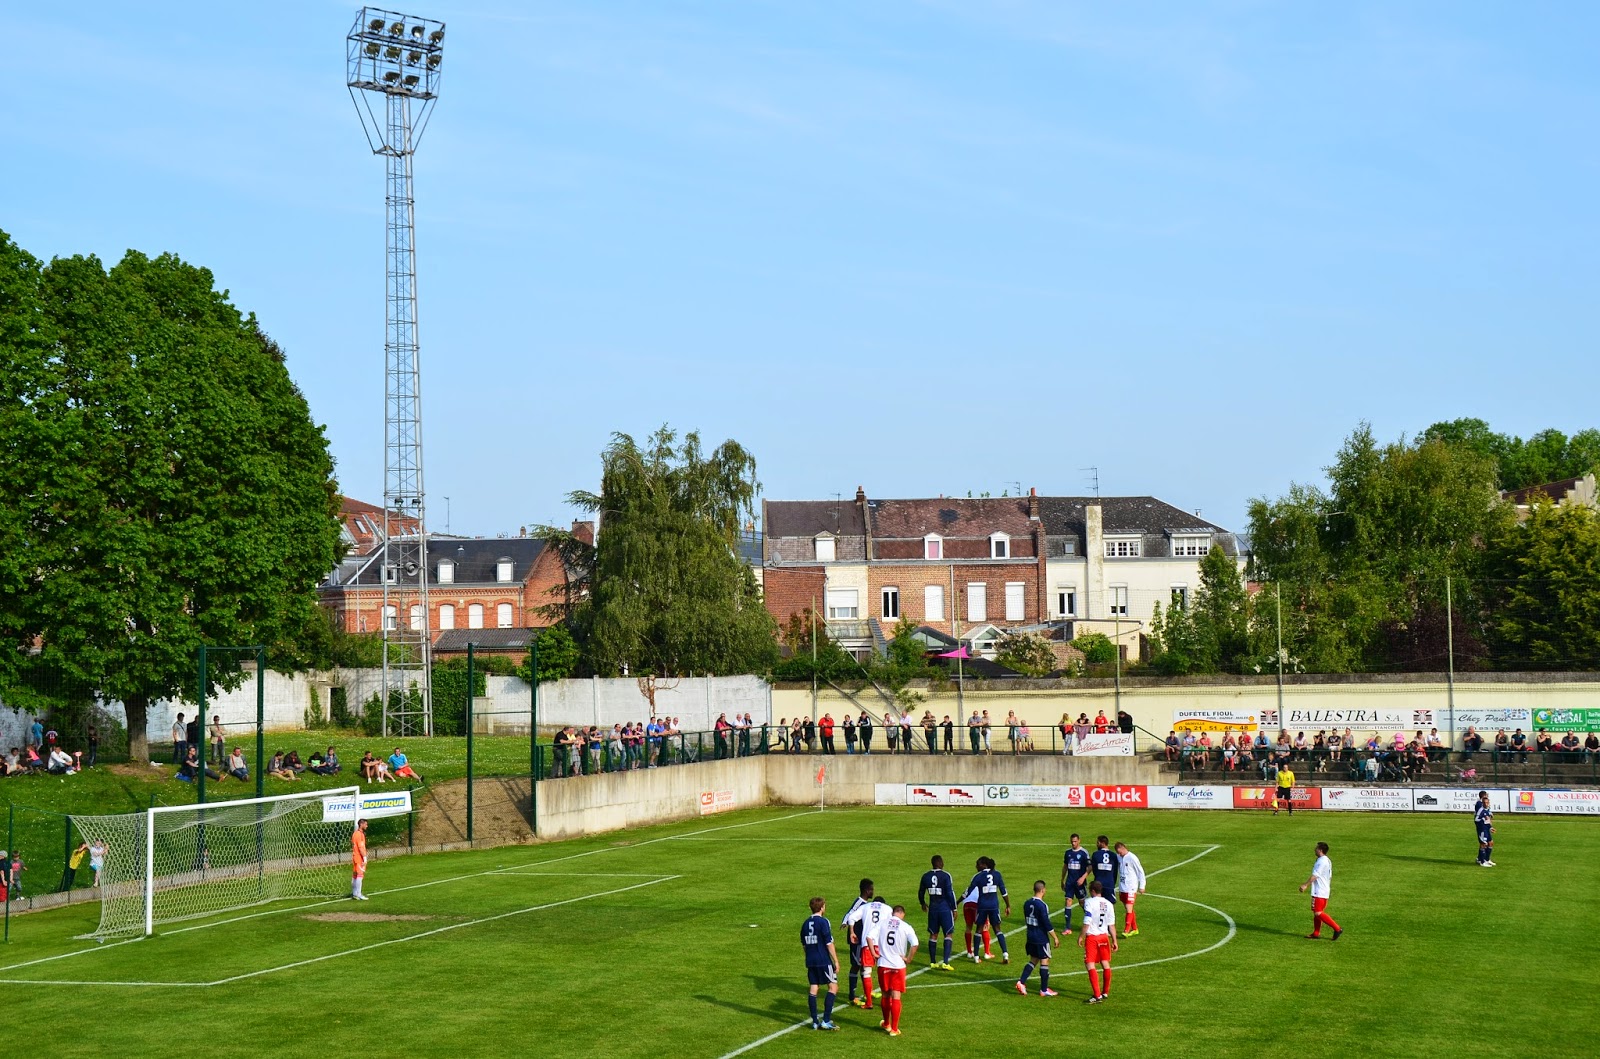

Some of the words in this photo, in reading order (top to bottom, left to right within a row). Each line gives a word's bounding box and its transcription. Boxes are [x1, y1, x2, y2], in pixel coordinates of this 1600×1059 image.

[1290, 710, 1379, 722] BALESTRA
[1385, 714, 1403, 722] S.A.
[1458, 714, 1481, 724] Chez
[1076, 742, 1100, 753] Allez
[1102, 735, 1131, 747] Arras!
[1090, 787, 1142, 805] Quick
[363, 799, 405, 809] BOUTIQUE
[1102, 852, 1110, 864] 8
[931, 874, 938, 888] 9
[986, 874, 994, 886] 3
[871, 910, 880, 924] 8
[1029, 904, 1035, 918] 2
[1098, 913, 1106, 928] 5
[808, 921, 815, 935] 5
[886, 930, 895, 946] 6
